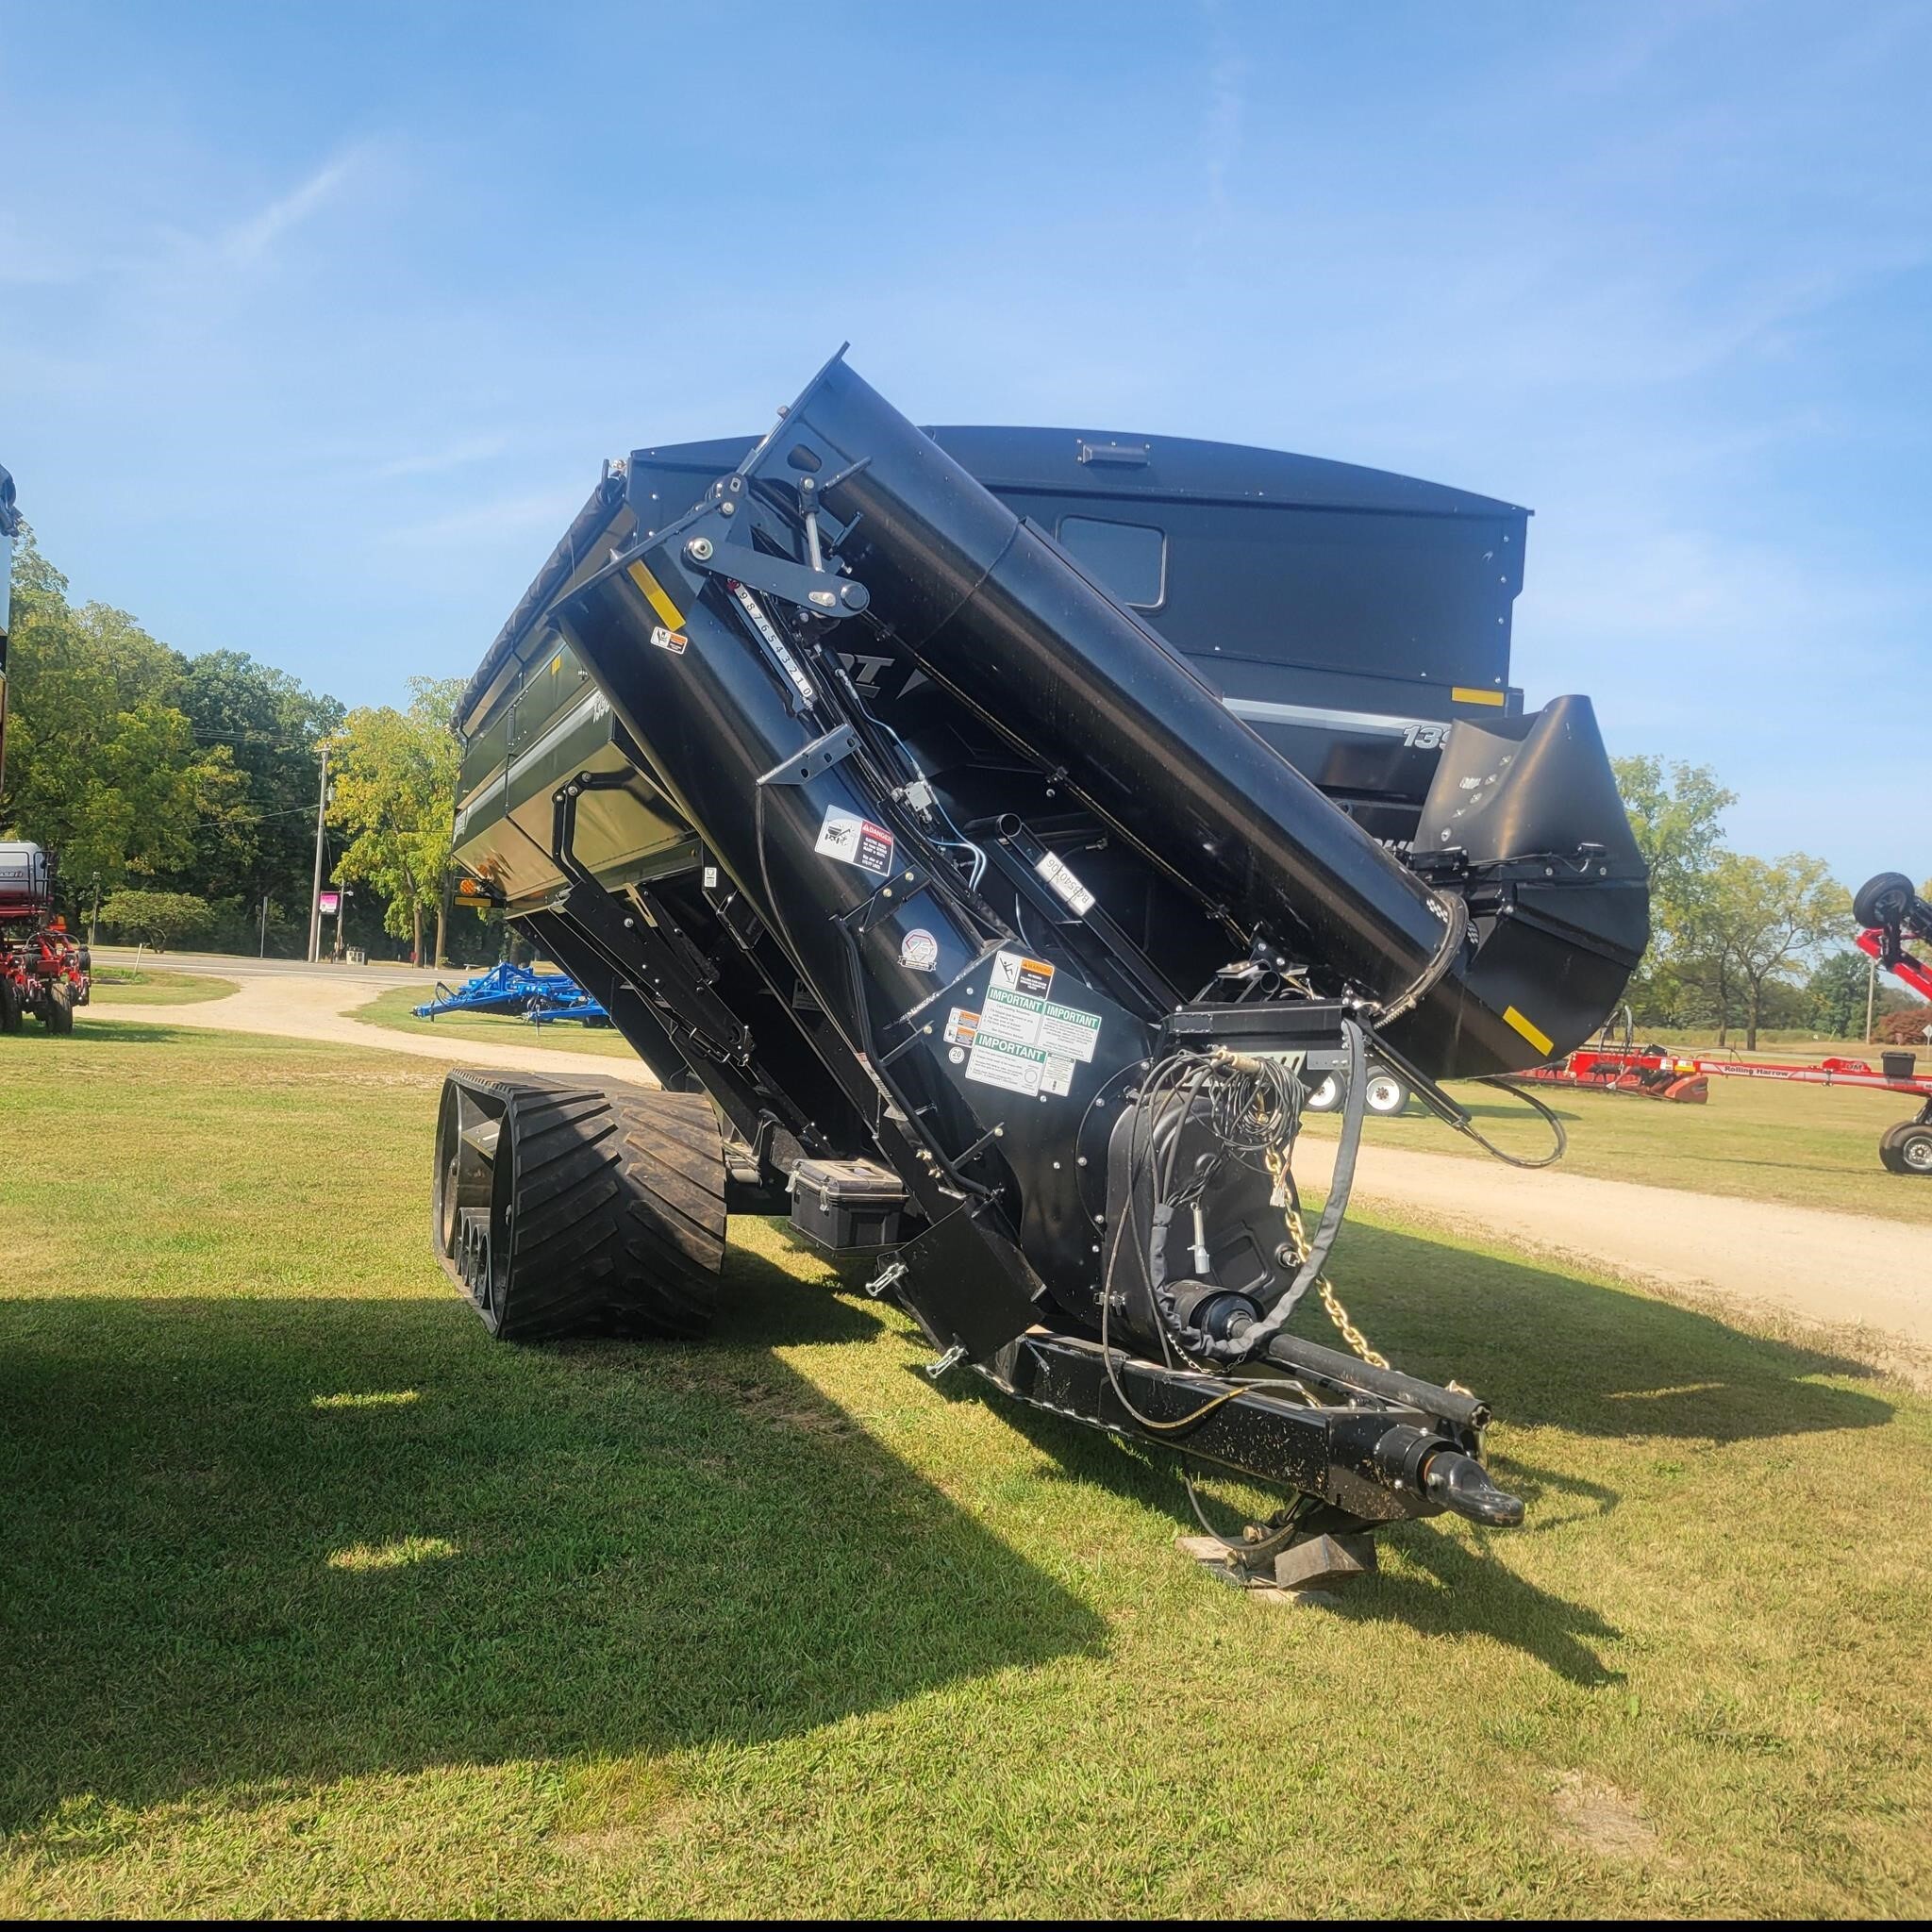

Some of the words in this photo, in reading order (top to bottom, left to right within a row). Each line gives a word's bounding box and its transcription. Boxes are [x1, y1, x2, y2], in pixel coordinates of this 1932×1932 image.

[990, 988, 1041, 1012] IMPORTANT
[1046, 1006, 1098, 1028] IMPORTANT
[978, 1035, 1043, 1061] IMPORTANT
[1724, 1066, 1754, 1075] Rolling
[1757, 1069, 1789, 1077] Harrow
